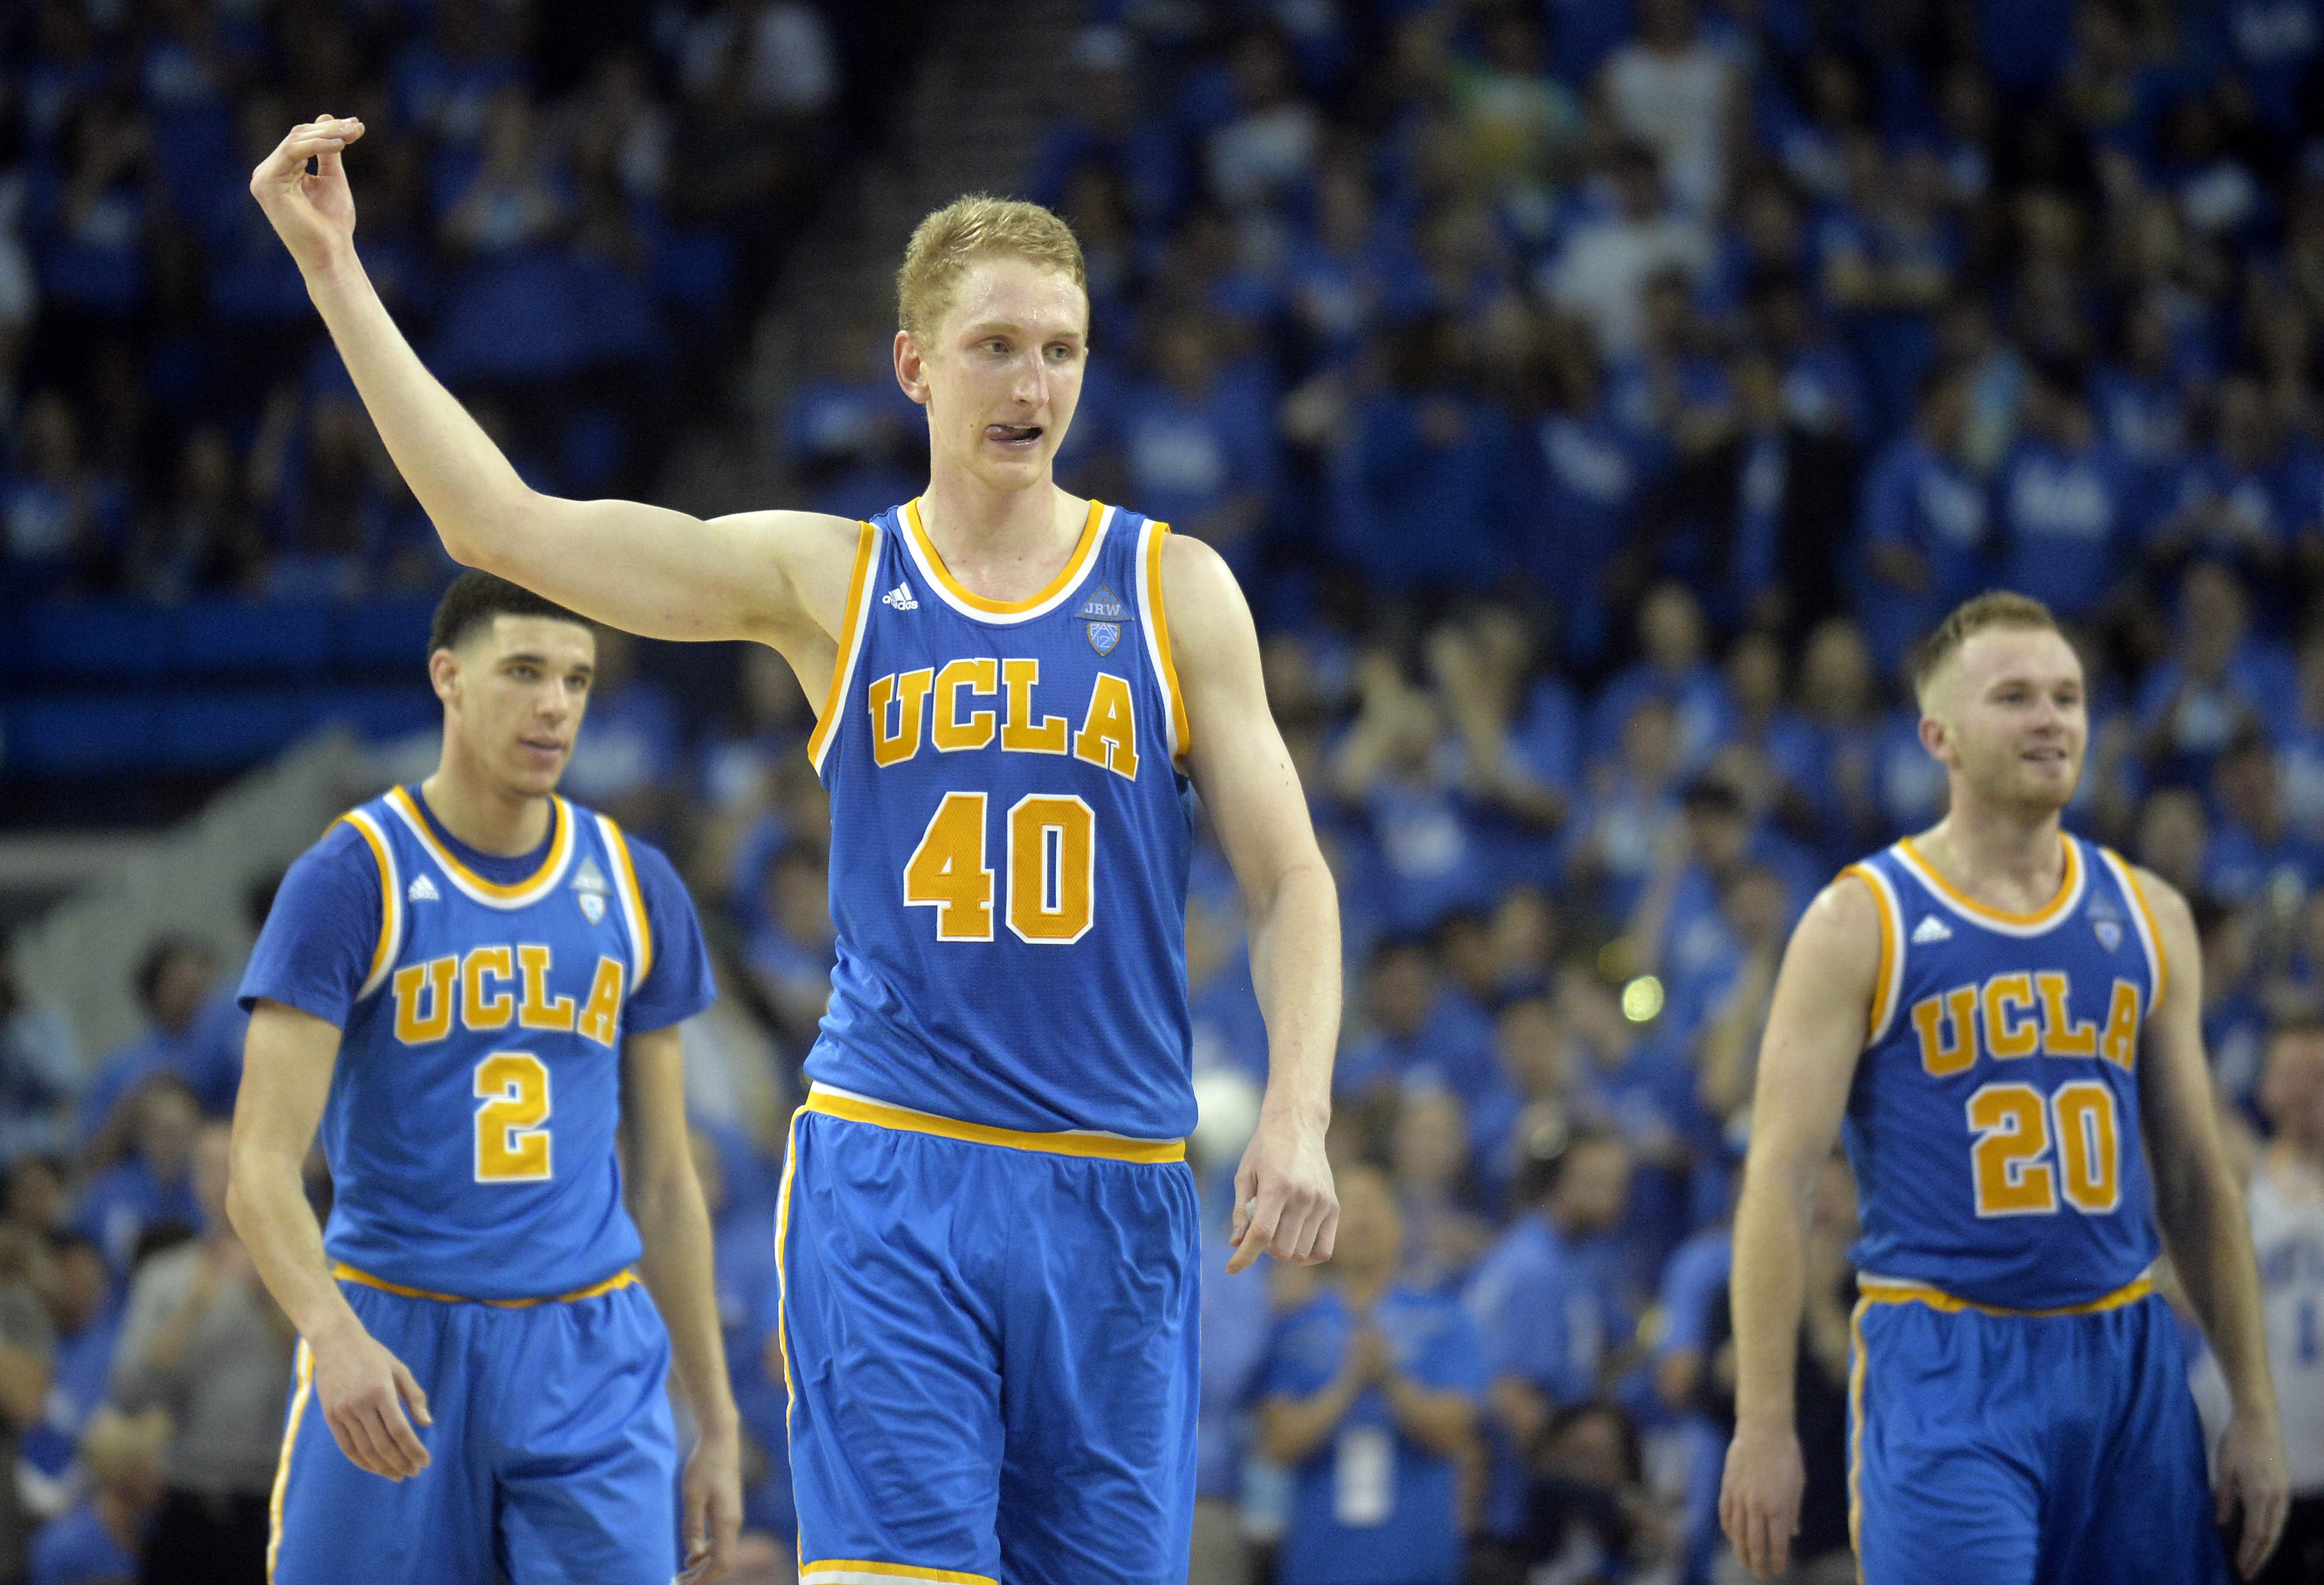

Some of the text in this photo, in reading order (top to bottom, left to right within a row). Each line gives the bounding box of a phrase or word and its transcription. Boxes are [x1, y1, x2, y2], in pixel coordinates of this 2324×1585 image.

[1084, 602, 1121, 617] JRW
[868, 657, 1139, 781] UCLA
[903, 791, 1095, 944] 40
[392, 943, 624, 1049] UCLA
[1911, 970, 2140, 1077] UCLA
[473, 1051, 552, 1183] 2
[1966, 1081, 2121, 1218] 20
